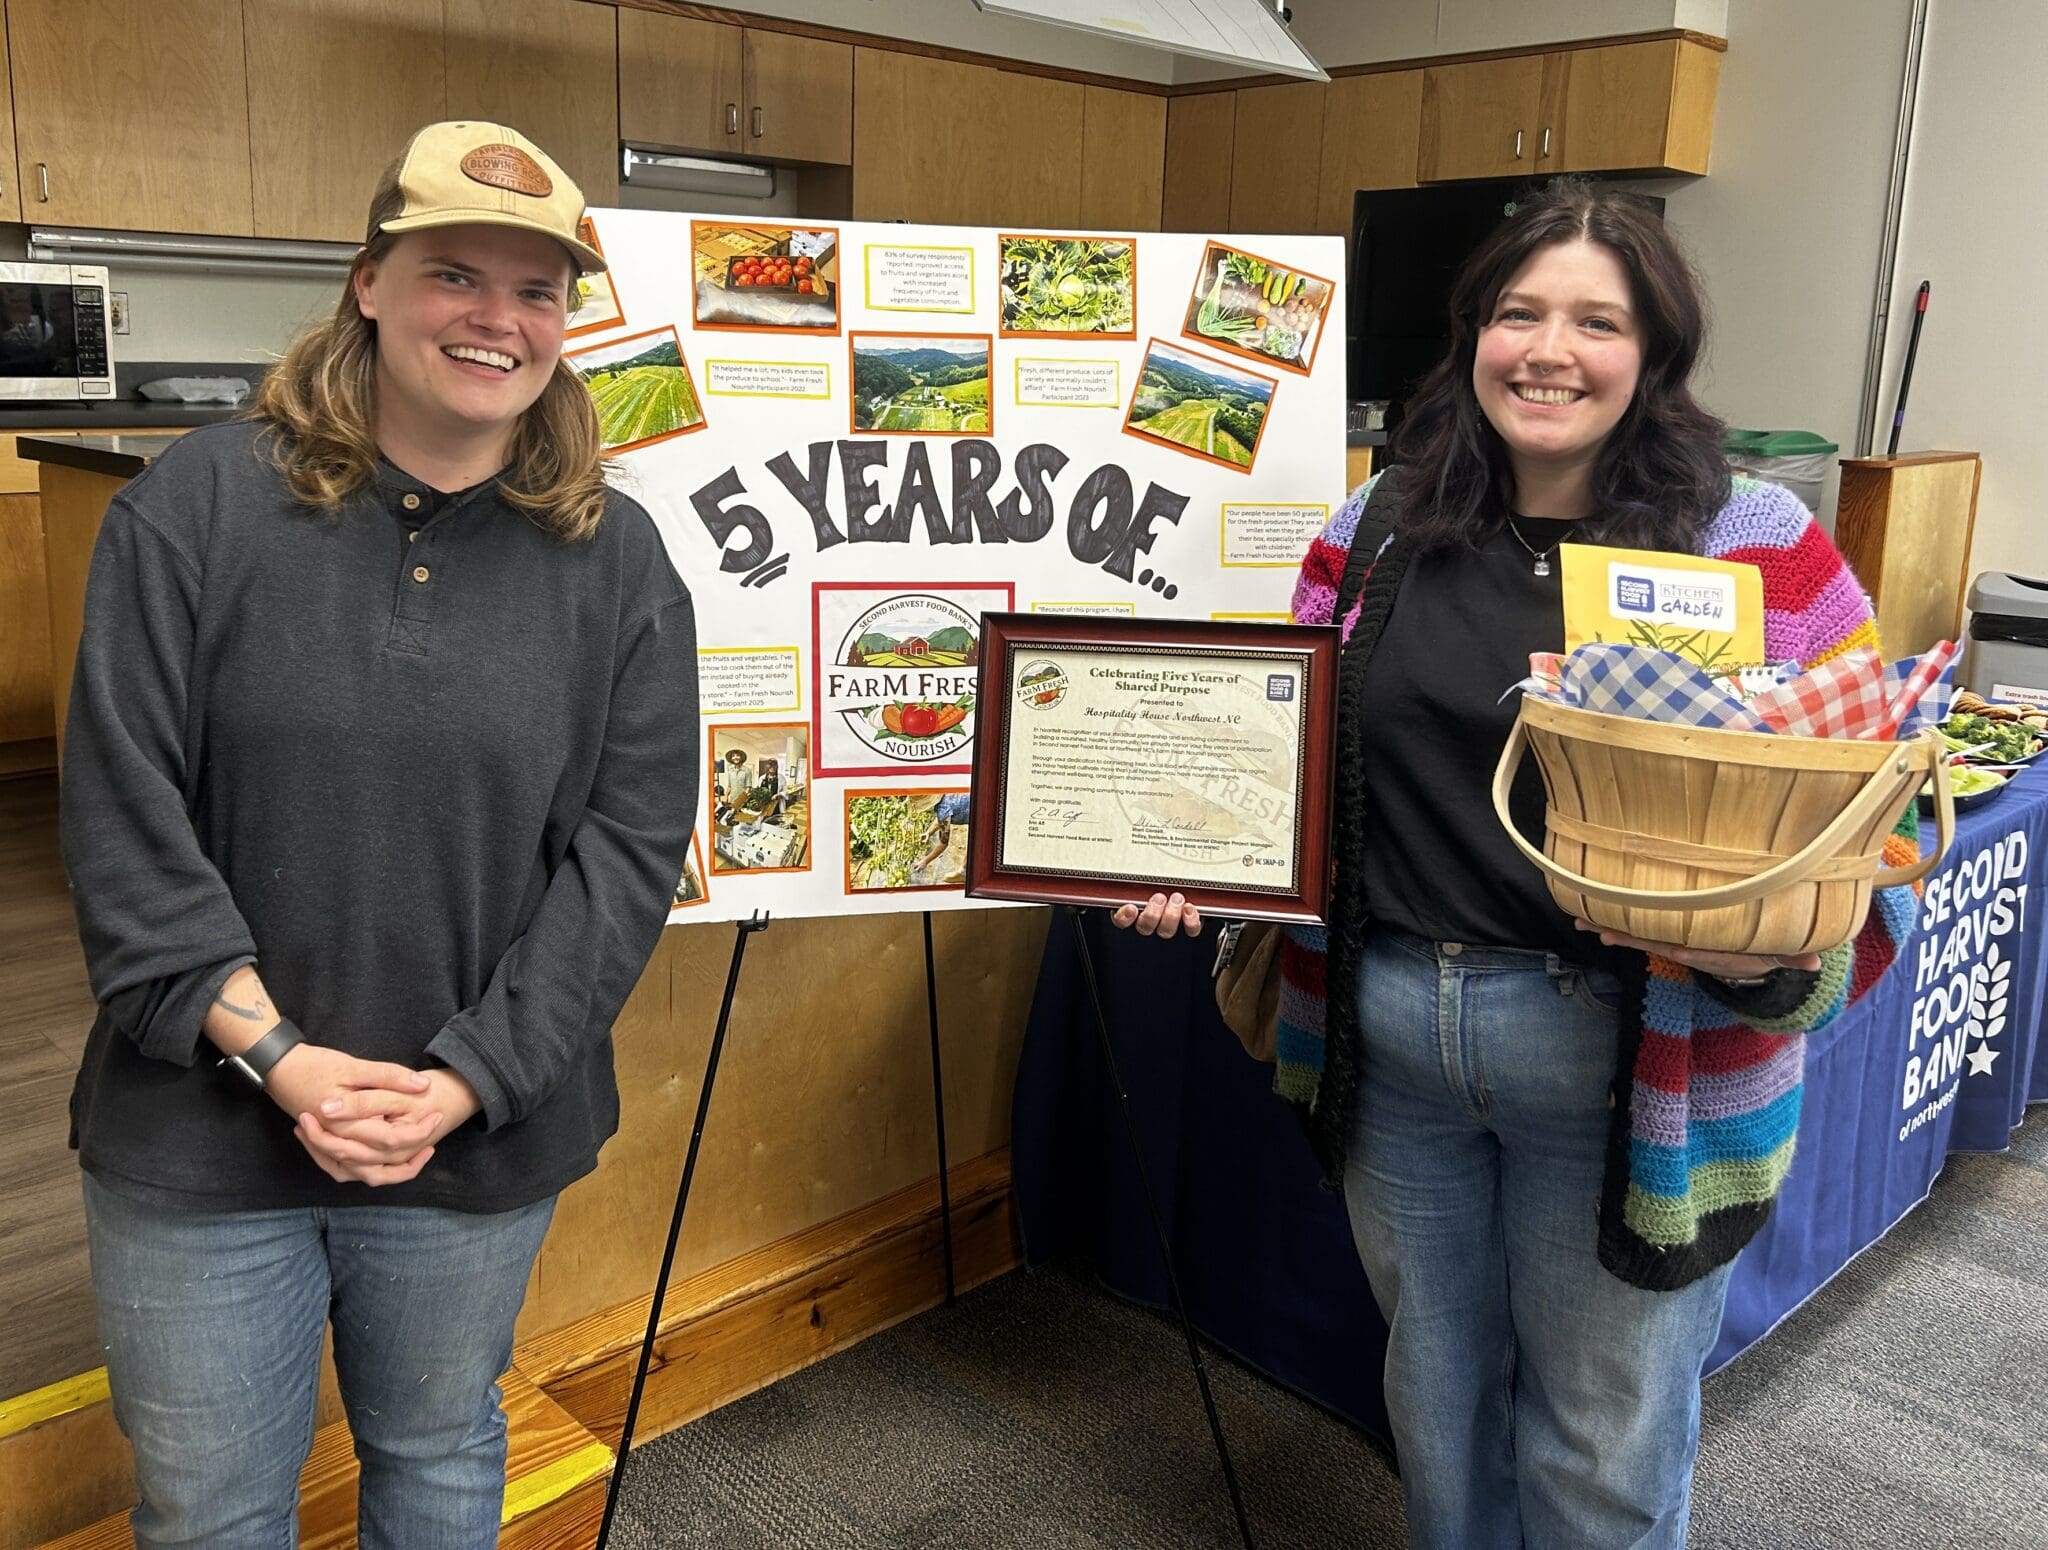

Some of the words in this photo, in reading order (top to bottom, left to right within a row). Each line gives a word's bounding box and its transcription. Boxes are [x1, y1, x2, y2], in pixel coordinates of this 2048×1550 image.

[470, 159, 518, 172] BLOWING
[689, 466, 773, 572] 5
[766, 440, 1069, 552] YEARS
[1663, 584, 1720, 599] KITCHEN
[859, 608, 888, 630] SECOND
[888, 600, 924, 613] HARVEST
[926, 601, 948, 613] FOOD
[948, 609, 974, 630] BANK'S
[1661, 598, 1722, 619] GARDEN
[828, 674, 909, 697] FARM
[918, 673, 978, 696] FRES
[1090, 668, 1159, 681] Celebrating
[1161, 671, 1188, 681] Five
[1192, 672, 1223, 683] Years
[1226, 674, 1241, 684] of
[1016, 685, 1041, 698] FARM
[1042, 676, 1069, 690] FRESH
[1115, 681, 1157, 692] Shared
[1160, 683, 1211, 695] Purpose
[1084, 706, 1136, 721] Hospitality
[1139, 709, 1169, 720] House
[1172, 711, 1220, 722] Northwest
[1223, 714, 1241, 724] NC
[884, 736, 957, 757] NOURISH
[1262, 858, 1285, 866] SNAP-ED
[1922, 830, 2028, 932] SECOND
[1899, 1119, 1911, 1142] of
